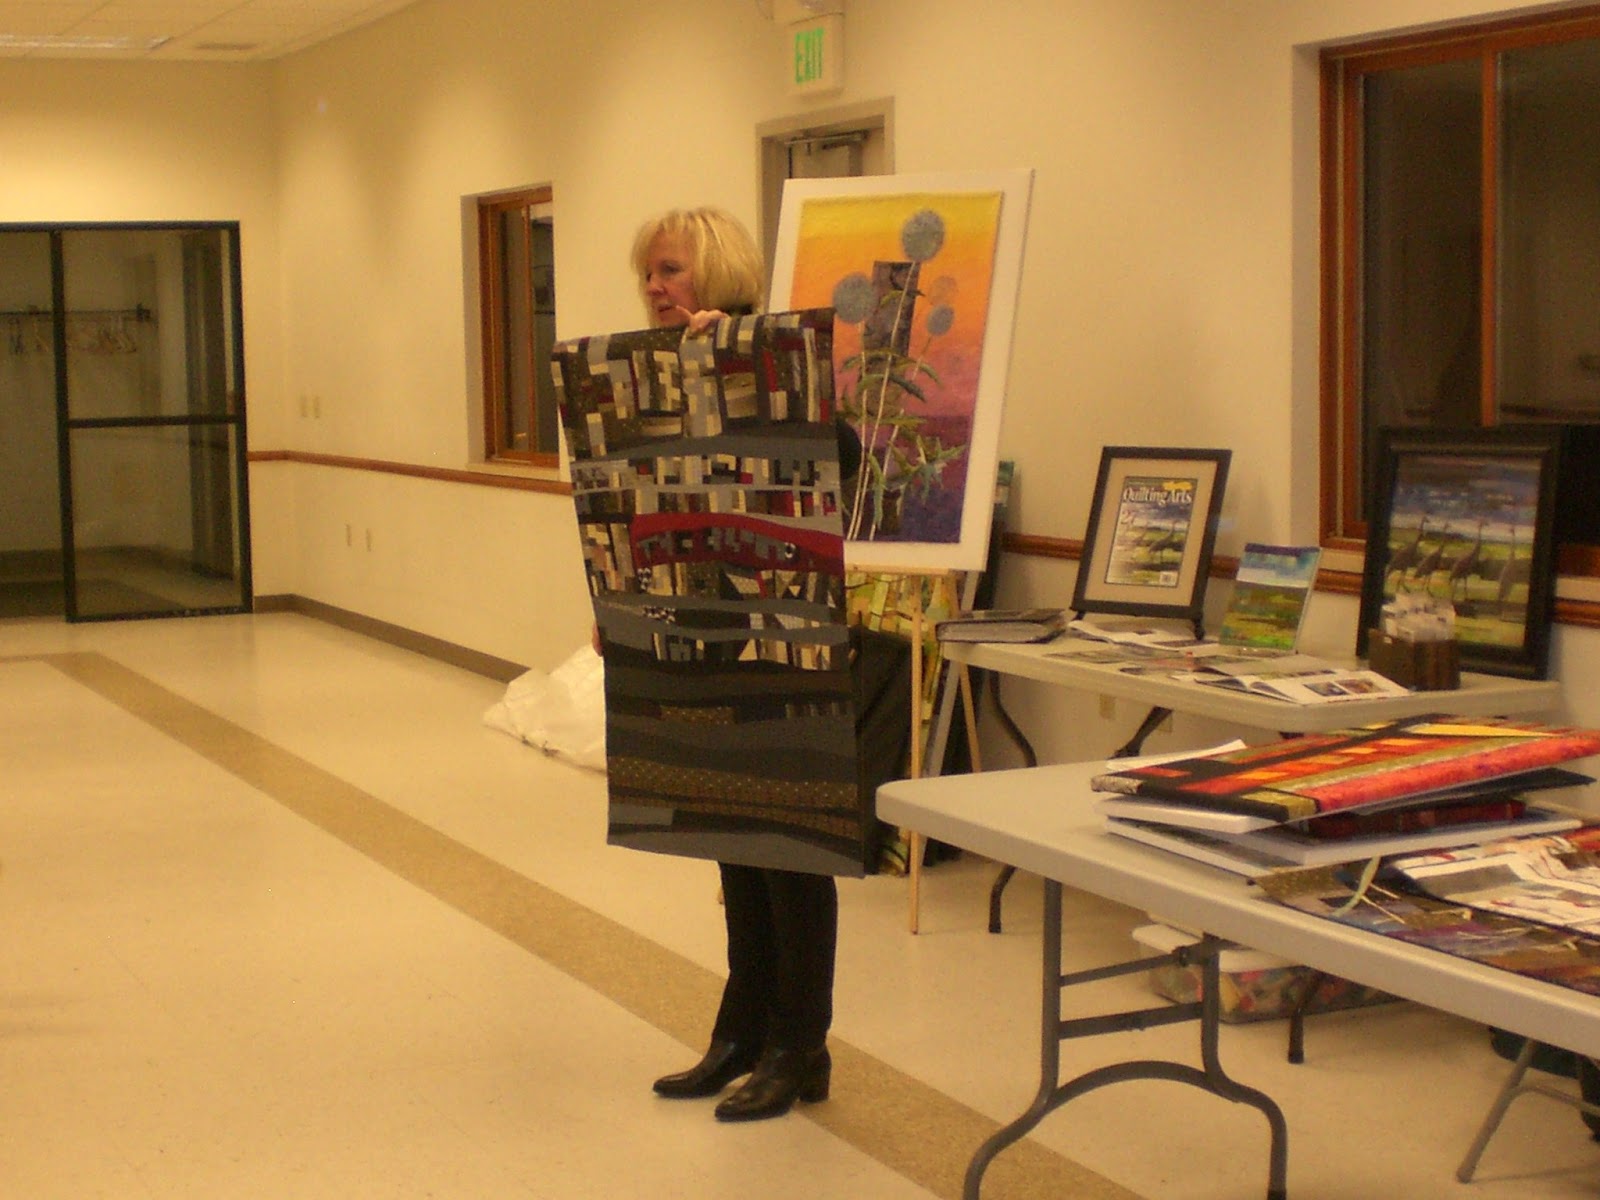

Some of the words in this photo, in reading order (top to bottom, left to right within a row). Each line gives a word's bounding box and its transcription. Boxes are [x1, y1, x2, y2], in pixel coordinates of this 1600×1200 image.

[795, 28, 824, 83] EXIT
[1123, 487, 1167, 506] Quilting
[1168, 489, 1192, 504] Arts
